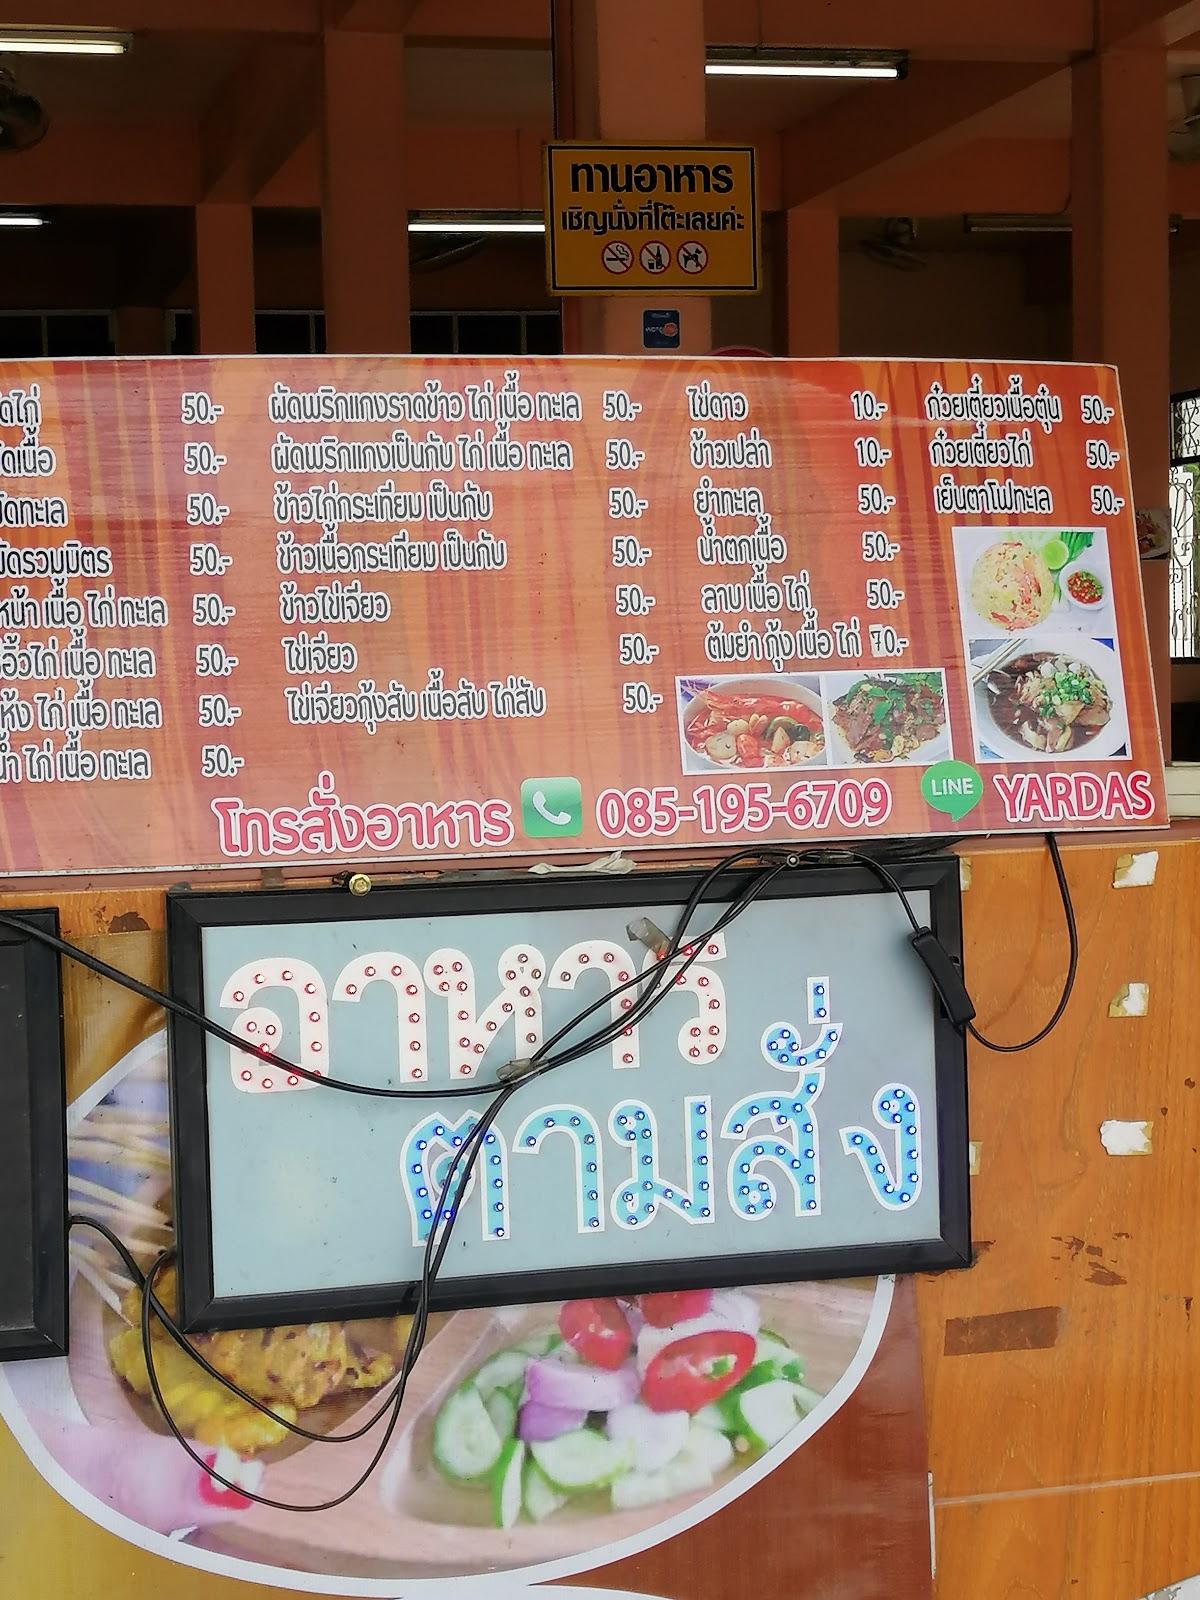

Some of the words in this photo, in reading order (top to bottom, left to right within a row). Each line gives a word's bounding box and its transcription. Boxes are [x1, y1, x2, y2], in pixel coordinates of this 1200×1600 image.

[570, 162, 734, 194] ทานอาหาร
[561, 199, 745, 236] เชิญนั่งที่โต๊ะเลยค่ะ
[183, 393, 223, 422] 50.-
[467, 380, 492, 421] ไก่
[499, 371, 532, 421] เนื้อ
[537, 393, 581, 421] ทะเล
[603, 393, 641, 420] 50.-
[687, 382, 747, 419] ไข่ดาว
[852, 392, 887, 419] 10.-
[926, 374, 1062, 432] ก๋วยเตี๋ยวเนื้อตุ๋น
[1081, 396, 1115, 423] 50.-
[185, 443, 227, 473] 50.-
[459, 430, 484, 470] ไก่
[489, 422, 524, 470] เนื้อ
[528, 441, 571, 469] ทะเล
[606, 440, 645, 468] 50.-
[691, 429, 771, 467] ข้าวเปล่า
[856, 438, 890, 465] 10.-
[930, 421, 1032, 467] ก๋วยเตี๋ยวไก่
[1087, 441, 1120, 468] 50.-
[187, 494, 230, 524] 50.-
[428, 480, 492, 520] เป็นกับ
[609, 488, 648, 518] 50.-
[695, 478, 763, 515] ยำทะเล
[858, 485, 895, 512] 50.-
[935, 475, 1052, 513] เย็นตาโฟทะเล
[1091, 486, 1125, 514] 50.-
[190, 544, 233, 574] 50.-
[443, 530, 507, 569] เป็นกับ
[612, 537, 652, 565] 50.-
[698, 515, 786, 564] น้ำตกเนื้อ
[863, 532, 899, 560] 50.-
[44, 578, 82, 626] เนื้อ
[86, 585, 114, 626] ไก่
[119, 596, 167, 626] ทะเล
[193, 594, 235, 624] 50.-
[279, 581, 390, 623] ข้าวไข่เจียว
[616, 586, 655, 614] 50.-
[702, 583, 742, 613] ลาบ
[748, 563, 781, 612] เนื้อ
[783, 570, 810, 610] ไก่
[867, 580, 904, 609] 50.-
[63, 628, 102, 677] เนื้อ
[107, 647, 154, 677] ทะเล
[196, 644, 238, 674] 50.-
[282, 631, 356, 673] ไข่เจียว
[619, 634, 659, 663] 50.-
[706, 619, 760, 662] ต้มยำ
[763, 620, 793, 671] กุ้ง
[798, 610, 833, 659] เนื้อ
[835, 617, 862, 658] ไก่
[869, 625, 909, 657] 70.-
[36, 688, 64, 729] ไก่
[70, 679, 108, 728] เนื้อ
[112, 697, 160, 727] ทะเล
[199, 695, 241, 725] 50.-
[422, 669, 489, 720] เนื้อสับ
[491, 677, 547, 717] ไก่สับ
[623, 683, 663, 712] 50.-
[24, 739, 52, 780] ไก่
[59, 730, 97, 779] เนื้อ
[101, 748, 150, 778] ทะเล
[201, 745, 244, 776] 50.-
[213, 772, 513, 854] โทรสั่งอาหาร
[597, 777, 891, 837] 085-195-6709
[930, 776, 974, 799] LINE
[995, 772, 1152, 822] YARDAS
[220, 932, 728, 1094] อาหาร
[400, 976, 924, 1248] ตามสั่ง
